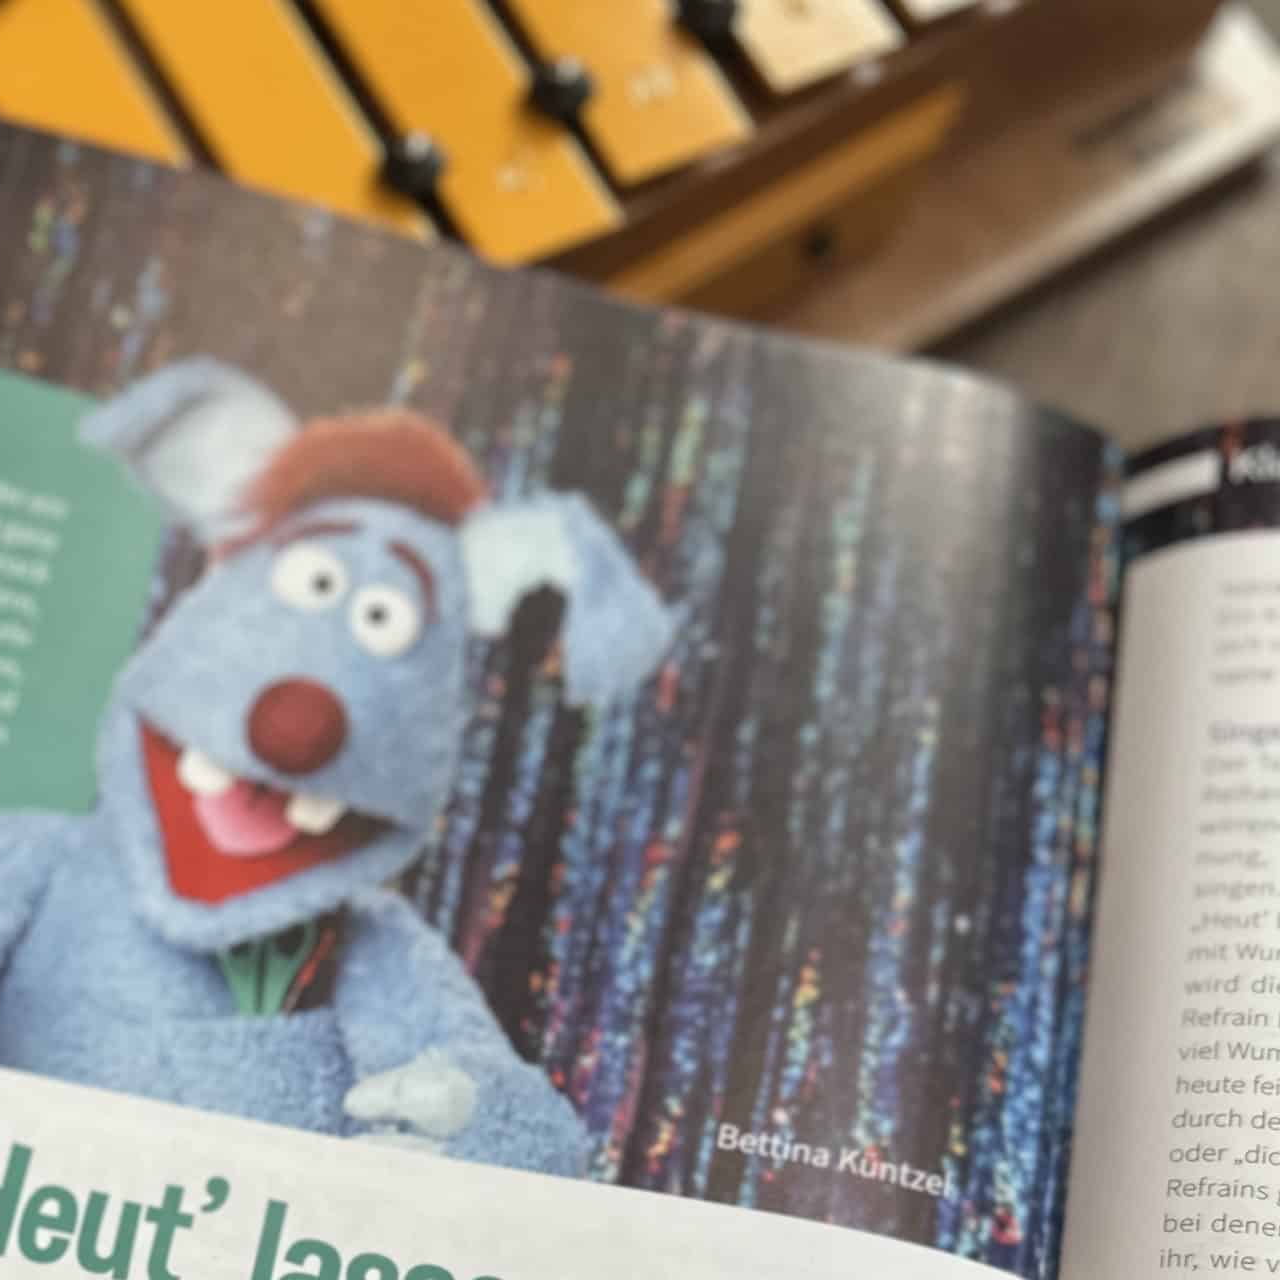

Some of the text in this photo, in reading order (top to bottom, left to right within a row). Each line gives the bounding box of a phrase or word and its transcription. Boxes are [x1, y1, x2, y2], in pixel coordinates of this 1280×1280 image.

[717, 1123, 951, 1198] Bettina Küntzel
[1166, 1178, 1269, 1202] Refrains
[1210, 1252, 1256, 1271] wie
